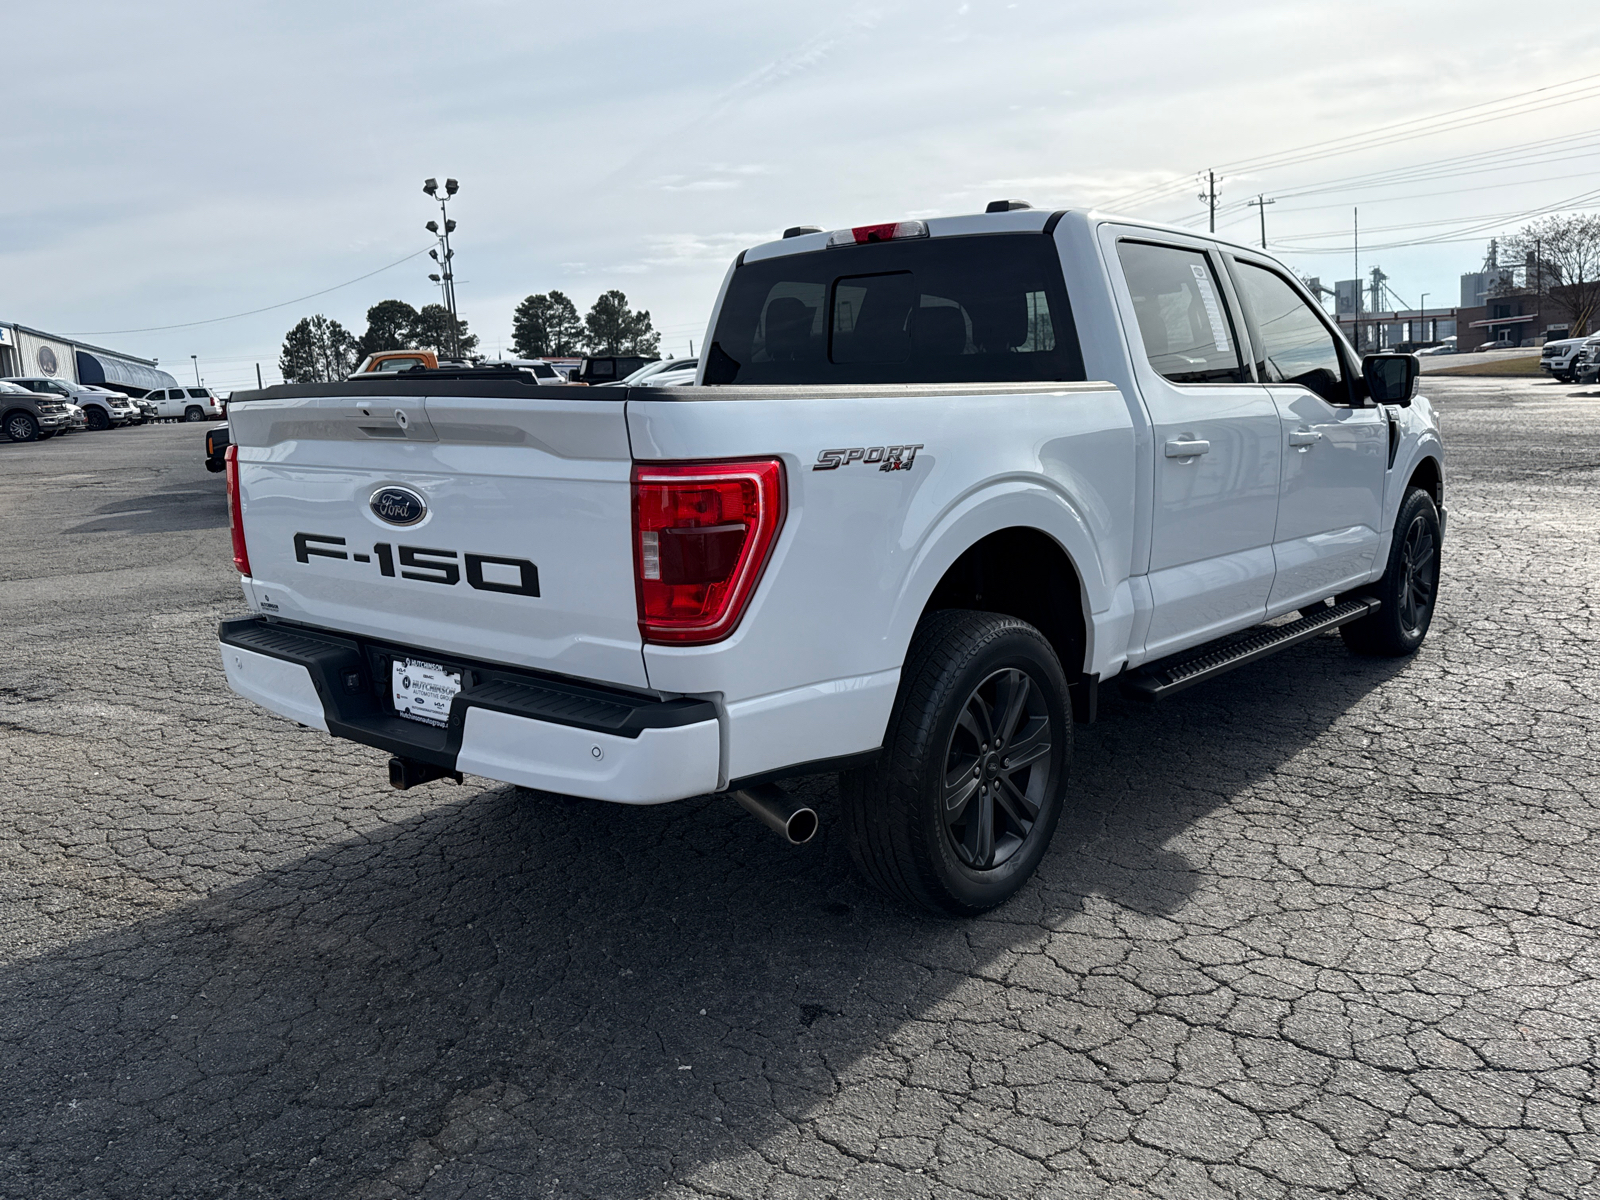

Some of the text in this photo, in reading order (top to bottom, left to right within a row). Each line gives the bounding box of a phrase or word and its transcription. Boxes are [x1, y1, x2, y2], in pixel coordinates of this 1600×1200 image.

[812, 444, 924, 471] SPORT
[379, 493, 410, 518] Ford
[293, 531, 541, 598] F-150
[411, 659, 444, 671] HUTCHINSON
[412, 680, 456, 695] HUTCHINSON
[413, 689, 439, 699] AUTOMOTIVE
[440, 694, 452, 702] GROU
